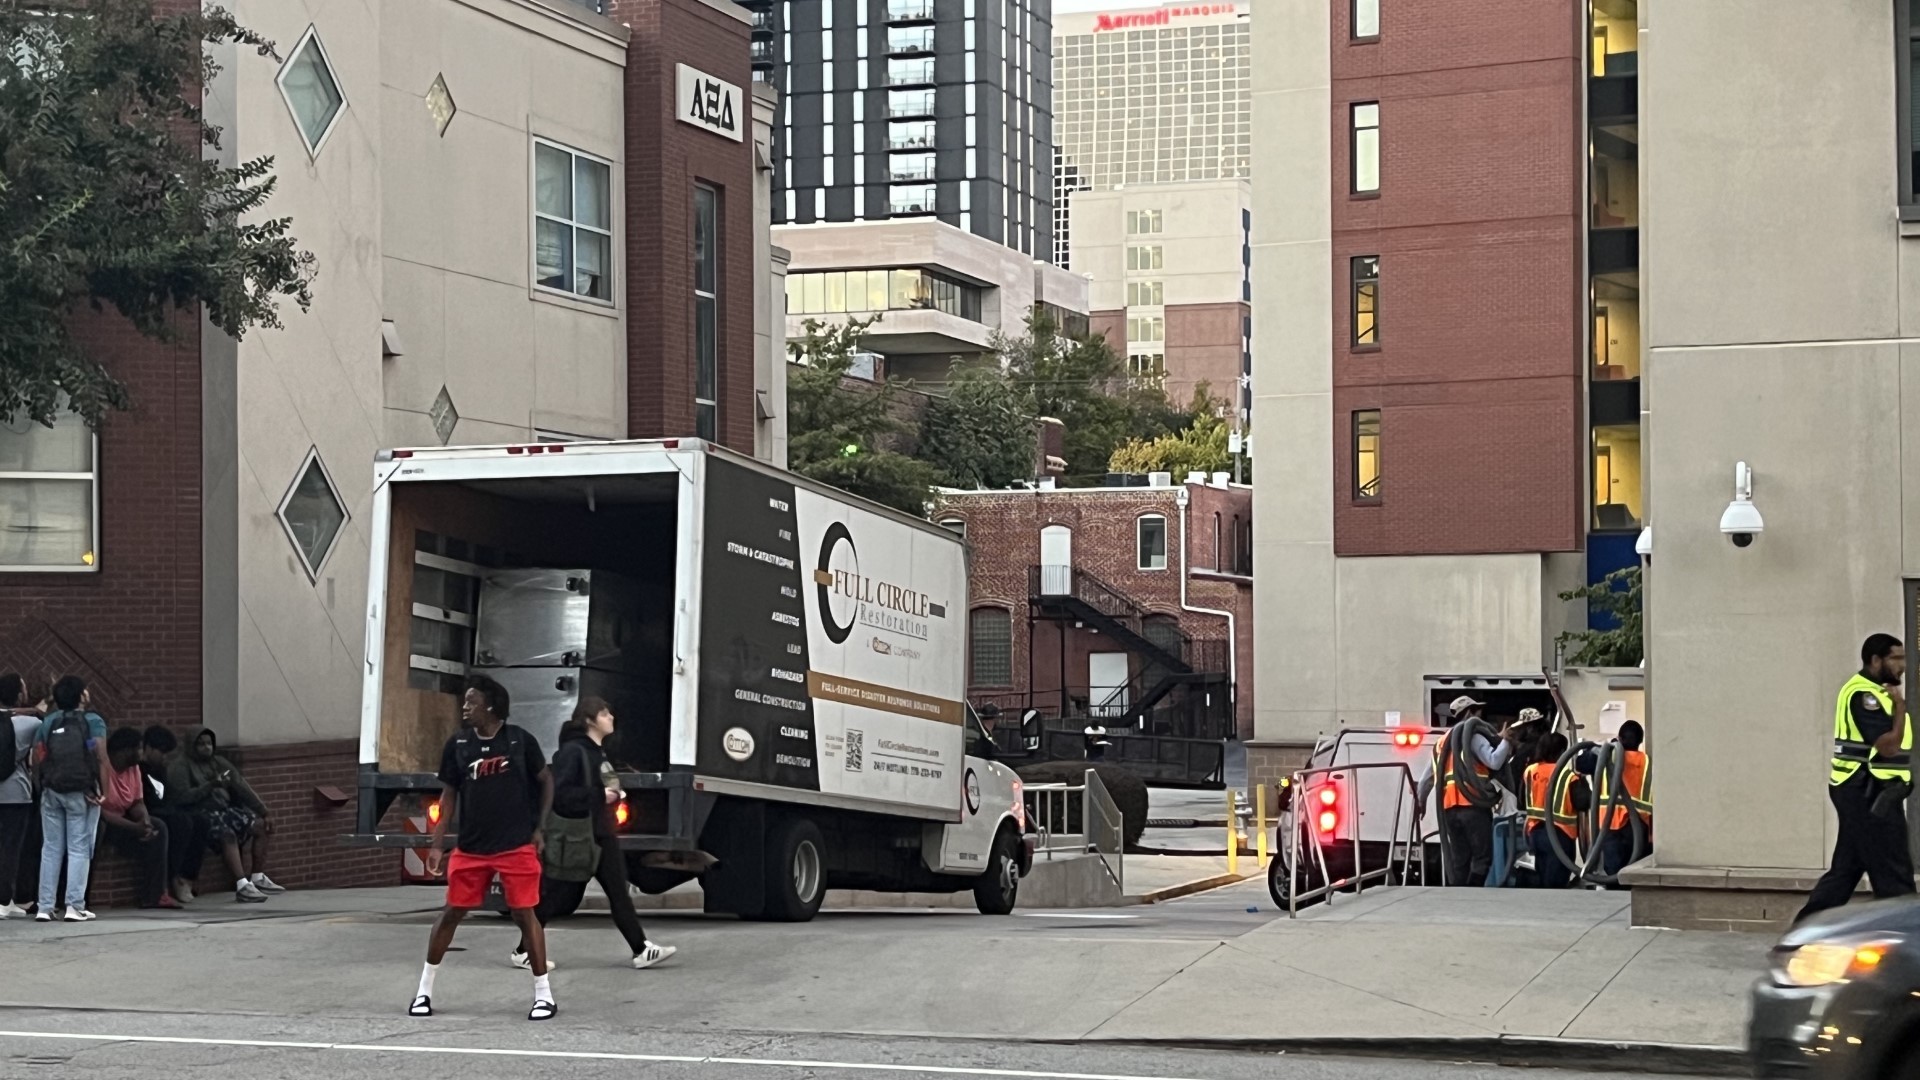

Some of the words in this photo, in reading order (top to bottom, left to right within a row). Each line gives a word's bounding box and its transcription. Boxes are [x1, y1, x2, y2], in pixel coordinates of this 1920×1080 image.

[1093, 8, 1169, 32] Marriott
[1171, 4, 1235, 17] MARQUIS
[727, 541, 748, 556] STORM
[834, 568, 873, 604] FULL
[877, 581, 929, 619] CIRCLE
[860, 603, 928, 638] Restoration
[734, 688, 761, 703] GENERAL
[762, 694, 806, 711] CONSTRUCTION
[780, 725, 809, 740] CLEANING
[776, 753, 811, 768] DEMOLITION
